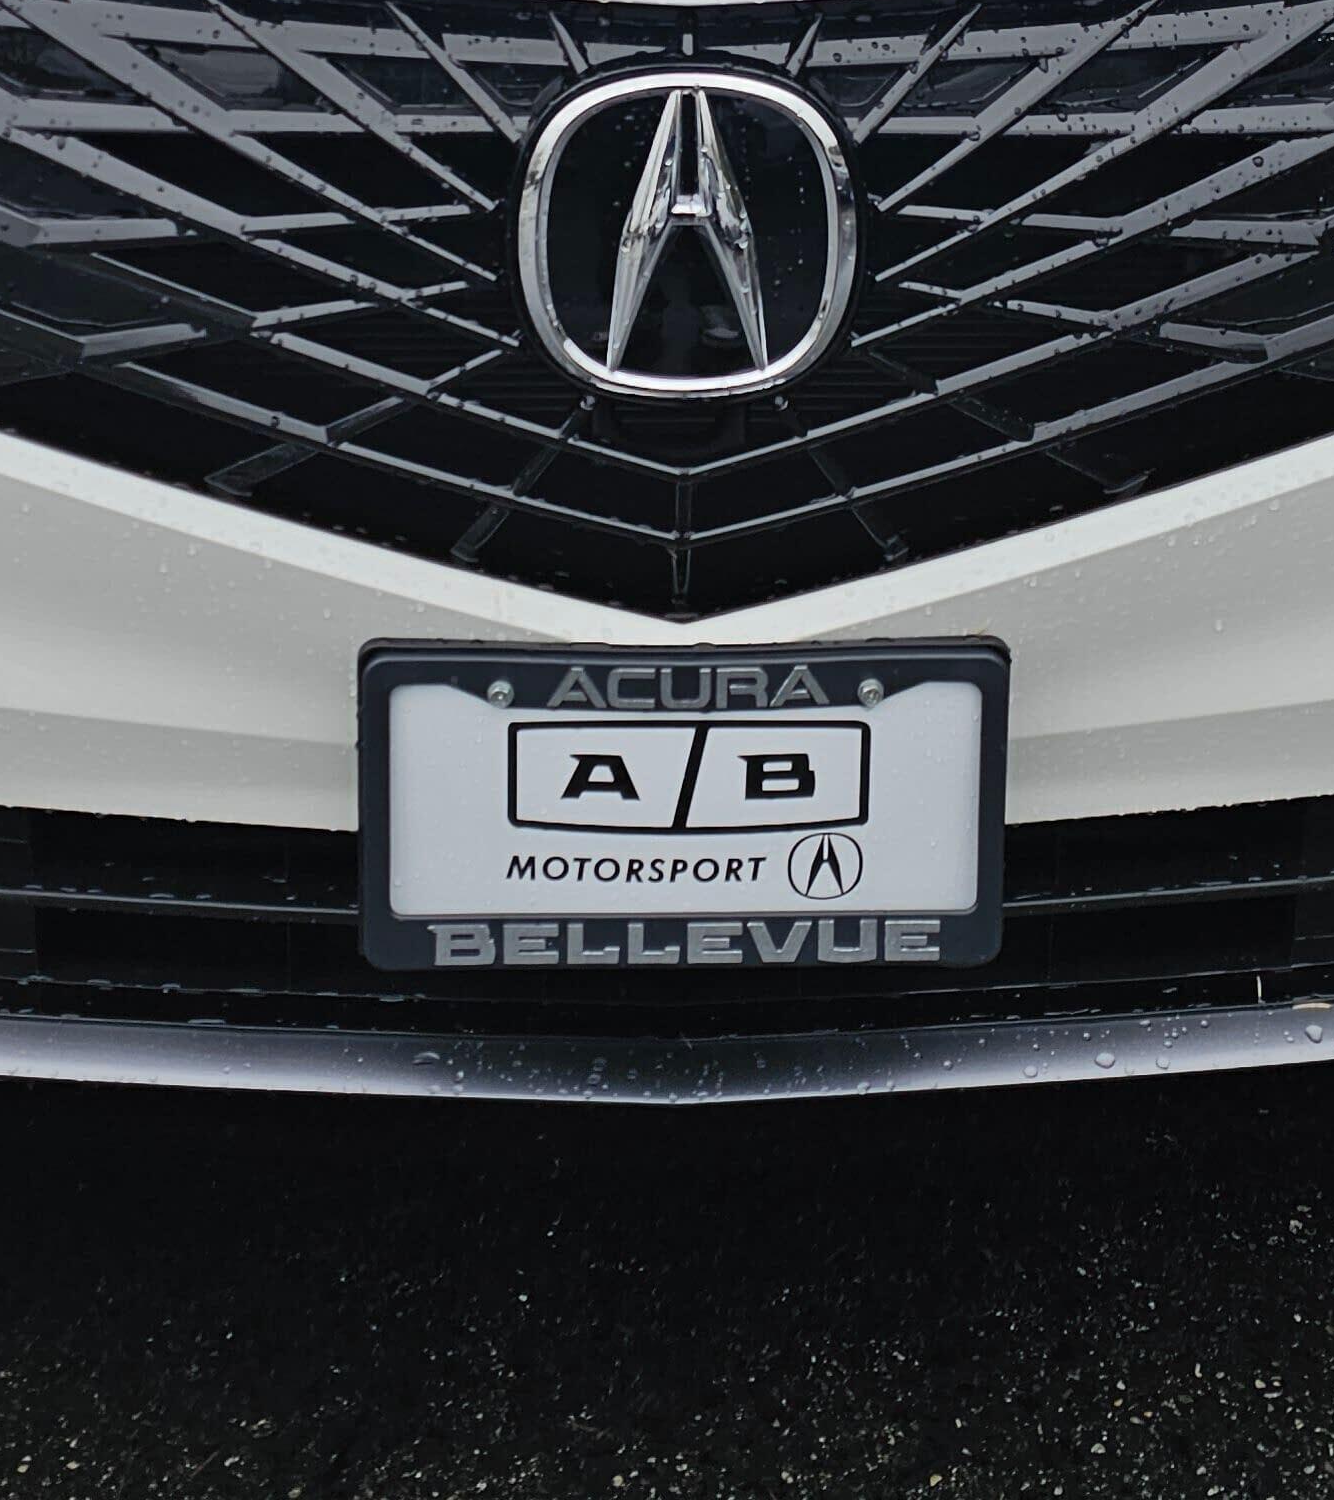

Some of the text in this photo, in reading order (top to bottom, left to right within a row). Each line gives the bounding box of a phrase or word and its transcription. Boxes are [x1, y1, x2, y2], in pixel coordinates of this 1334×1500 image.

[547, 665, 830, 710] ACURA
[506, 855, 768, 884] MOTORSPORT
[427, 918, 942, 967] BELLEVUE
